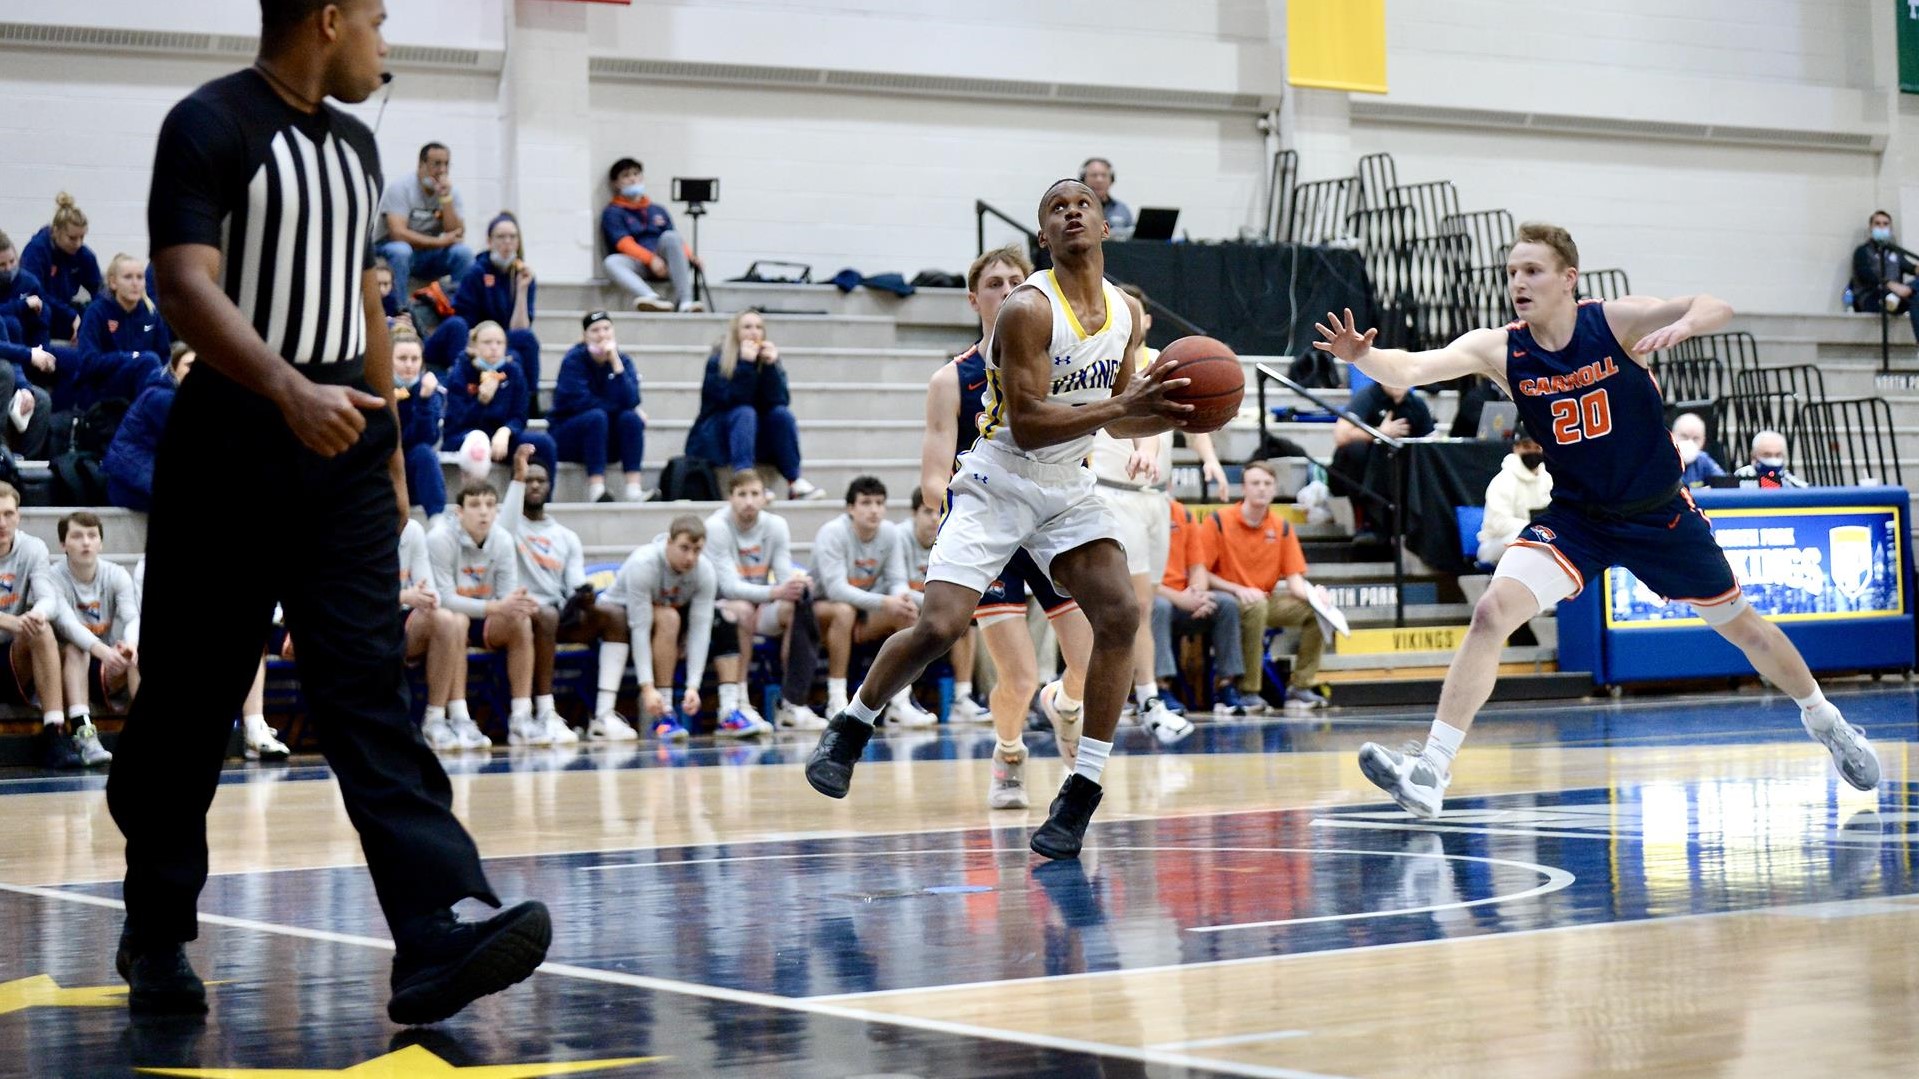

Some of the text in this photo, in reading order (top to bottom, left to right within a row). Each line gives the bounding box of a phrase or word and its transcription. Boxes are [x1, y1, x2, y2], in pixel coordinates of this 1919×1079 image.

[1052, 359, 1121, 395] VIKING
[1519, 356, 1619, 396] CARROLL
[1551, 388, 1612, 445] 20
[1392, 631, 1454, 649] VIKINGS
